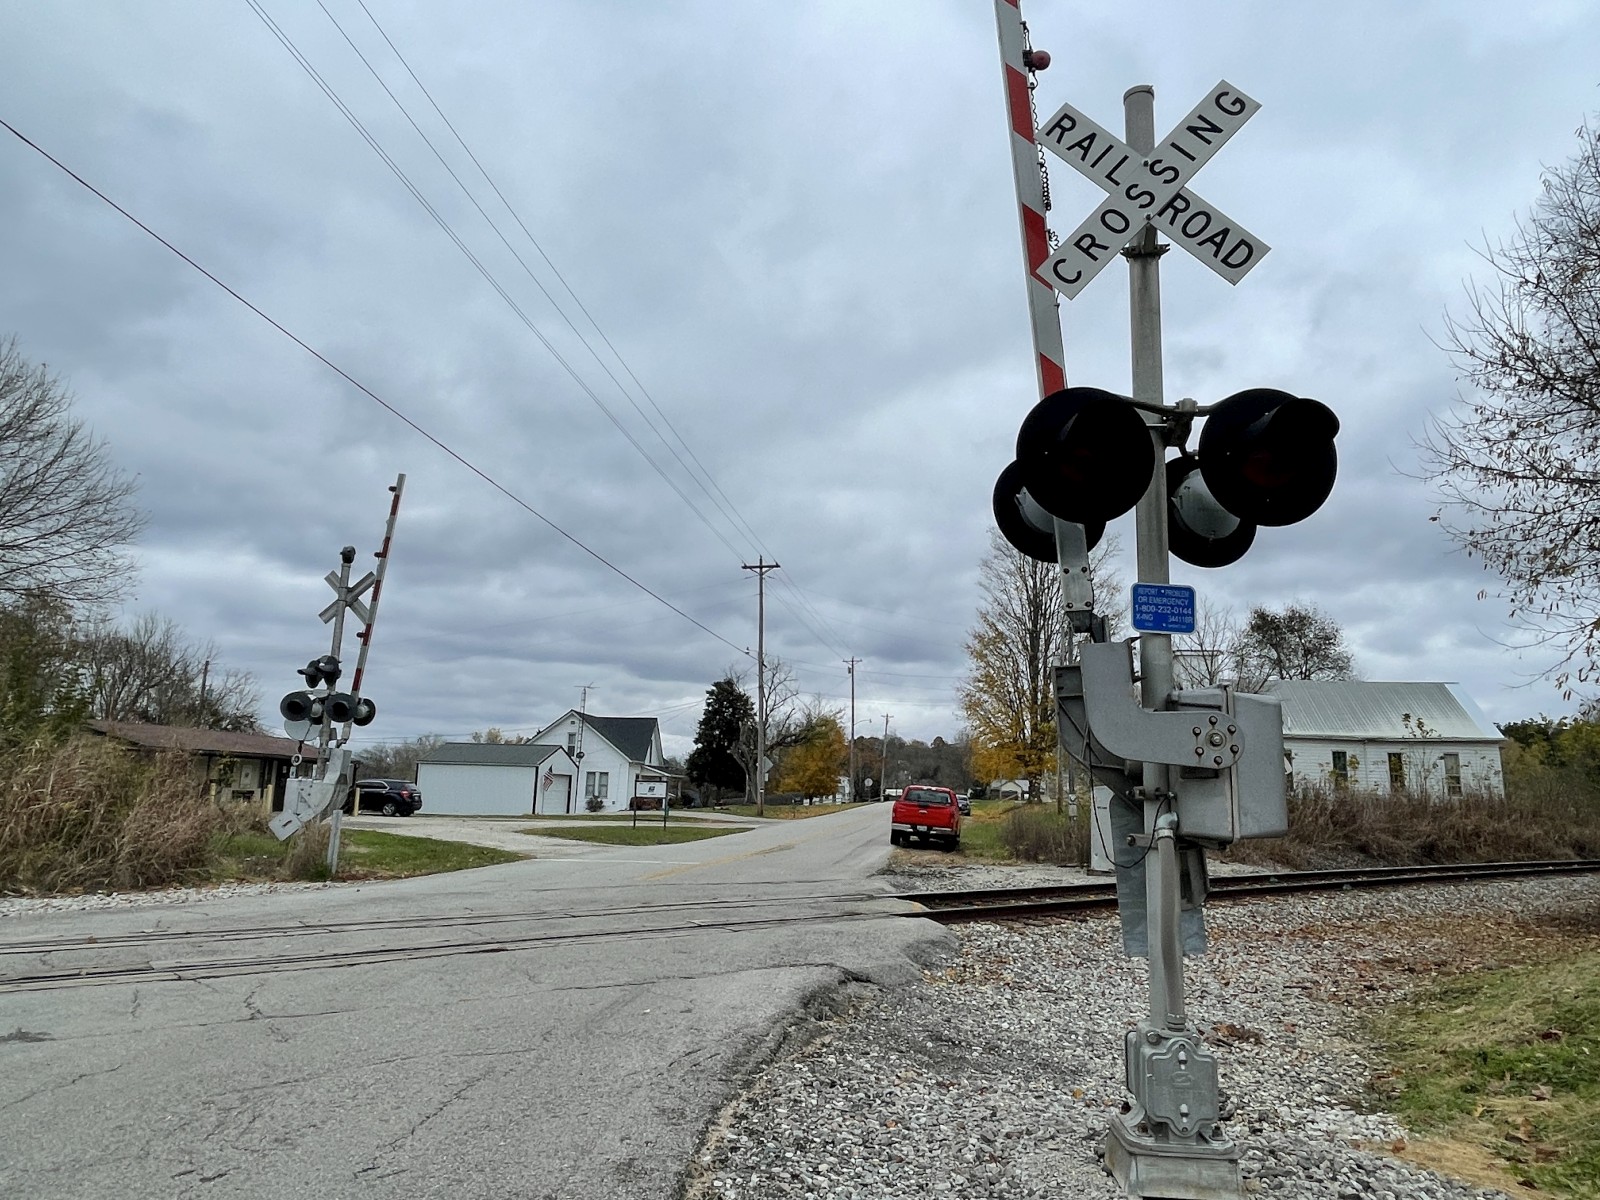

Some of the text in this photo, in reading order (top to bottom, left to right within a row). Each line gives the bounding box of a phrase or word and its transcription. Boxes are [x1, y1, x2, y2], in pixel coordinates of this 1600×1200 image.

[1045, 112, 1254, 270] RAIL ROAD
[1053, 91, 1247, 285] CROSSING
[1135, 604, 1192, 614] 1-800-232-0144
[1138, 595, 1189, 606] OR EMERGENCY
